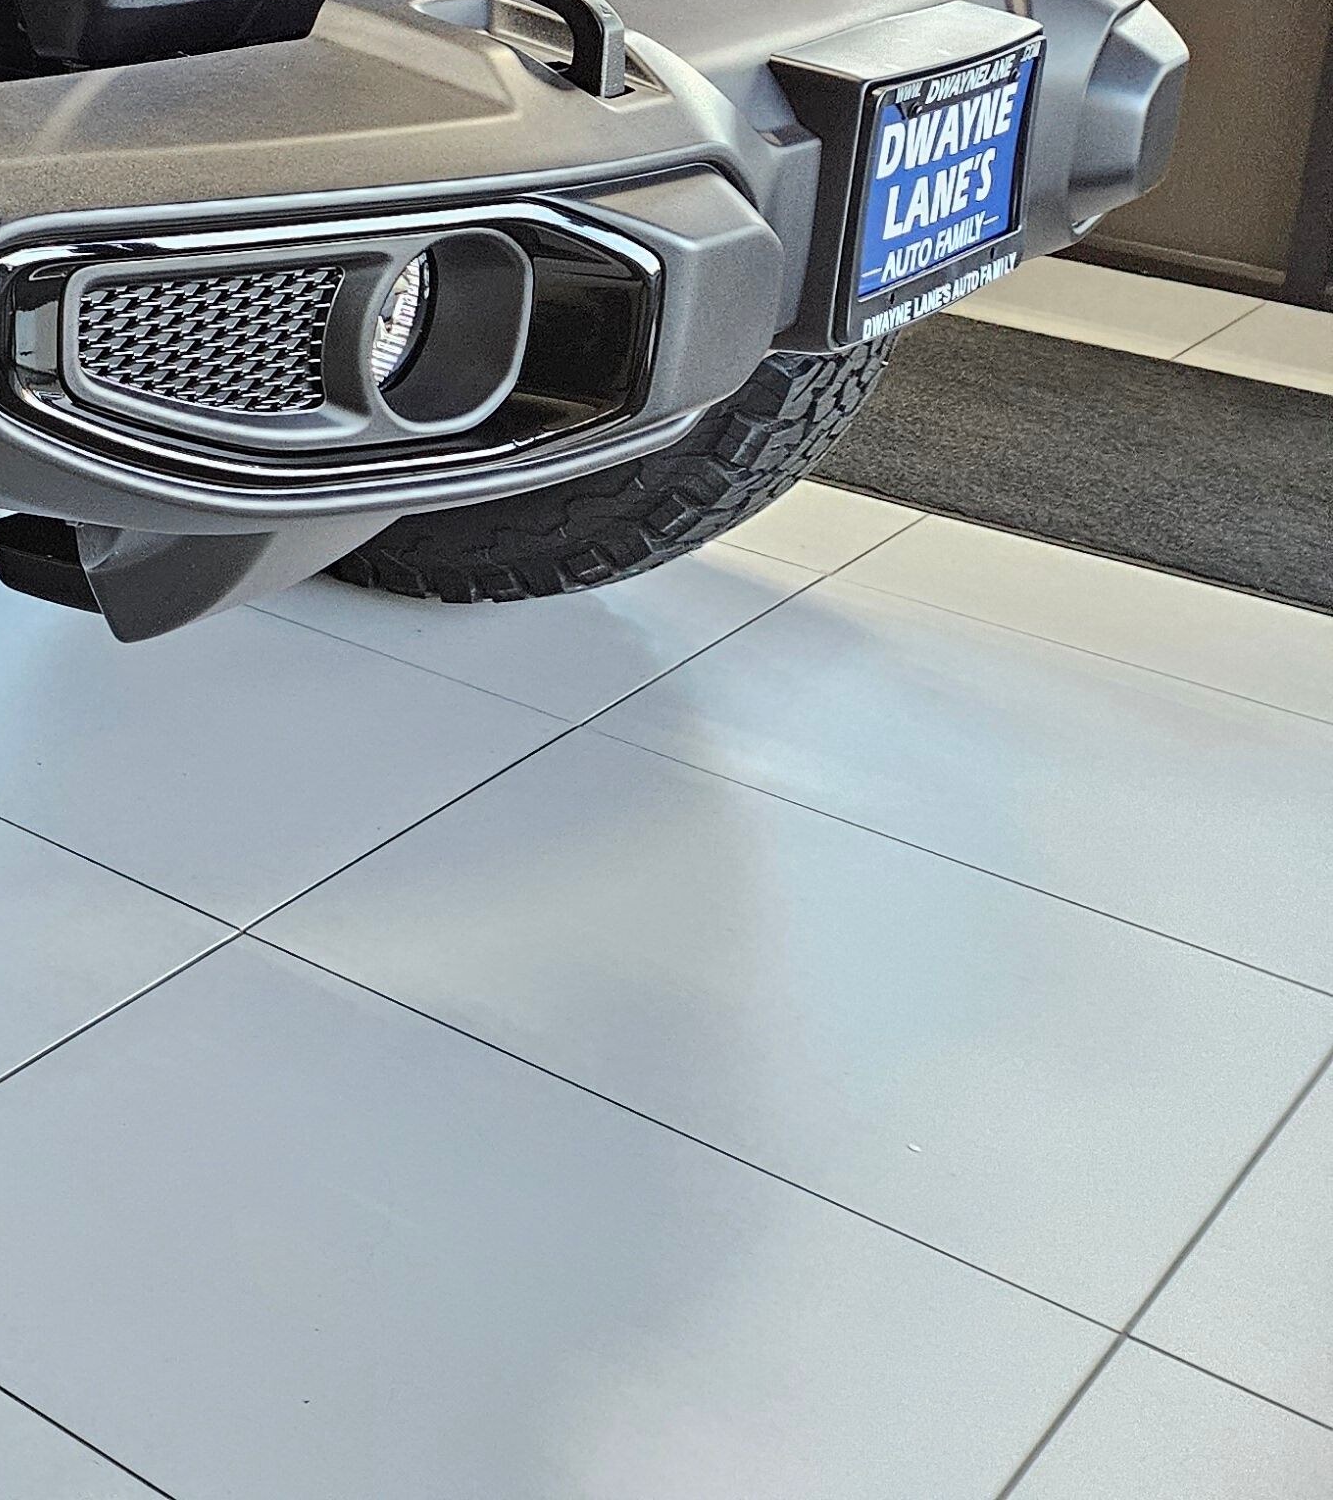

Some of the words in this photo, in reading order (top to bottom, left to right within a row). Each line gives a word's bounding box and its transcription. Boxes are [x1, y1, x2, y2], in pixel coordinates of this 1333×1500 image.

[876, 82, 1019, 180] DWAYNE
[883, 148, 997, 241] LANE'S
[880, 237, 933, 284] AUTO
[933, 211, 987, 261] FAMILY
[862, 301, 913, 341] DWAYNE
[912, 285, 953, 319] LANE'S
[950, 270, 980, 300] AUTO
[979, 251, 1018, 286] FAMILY
